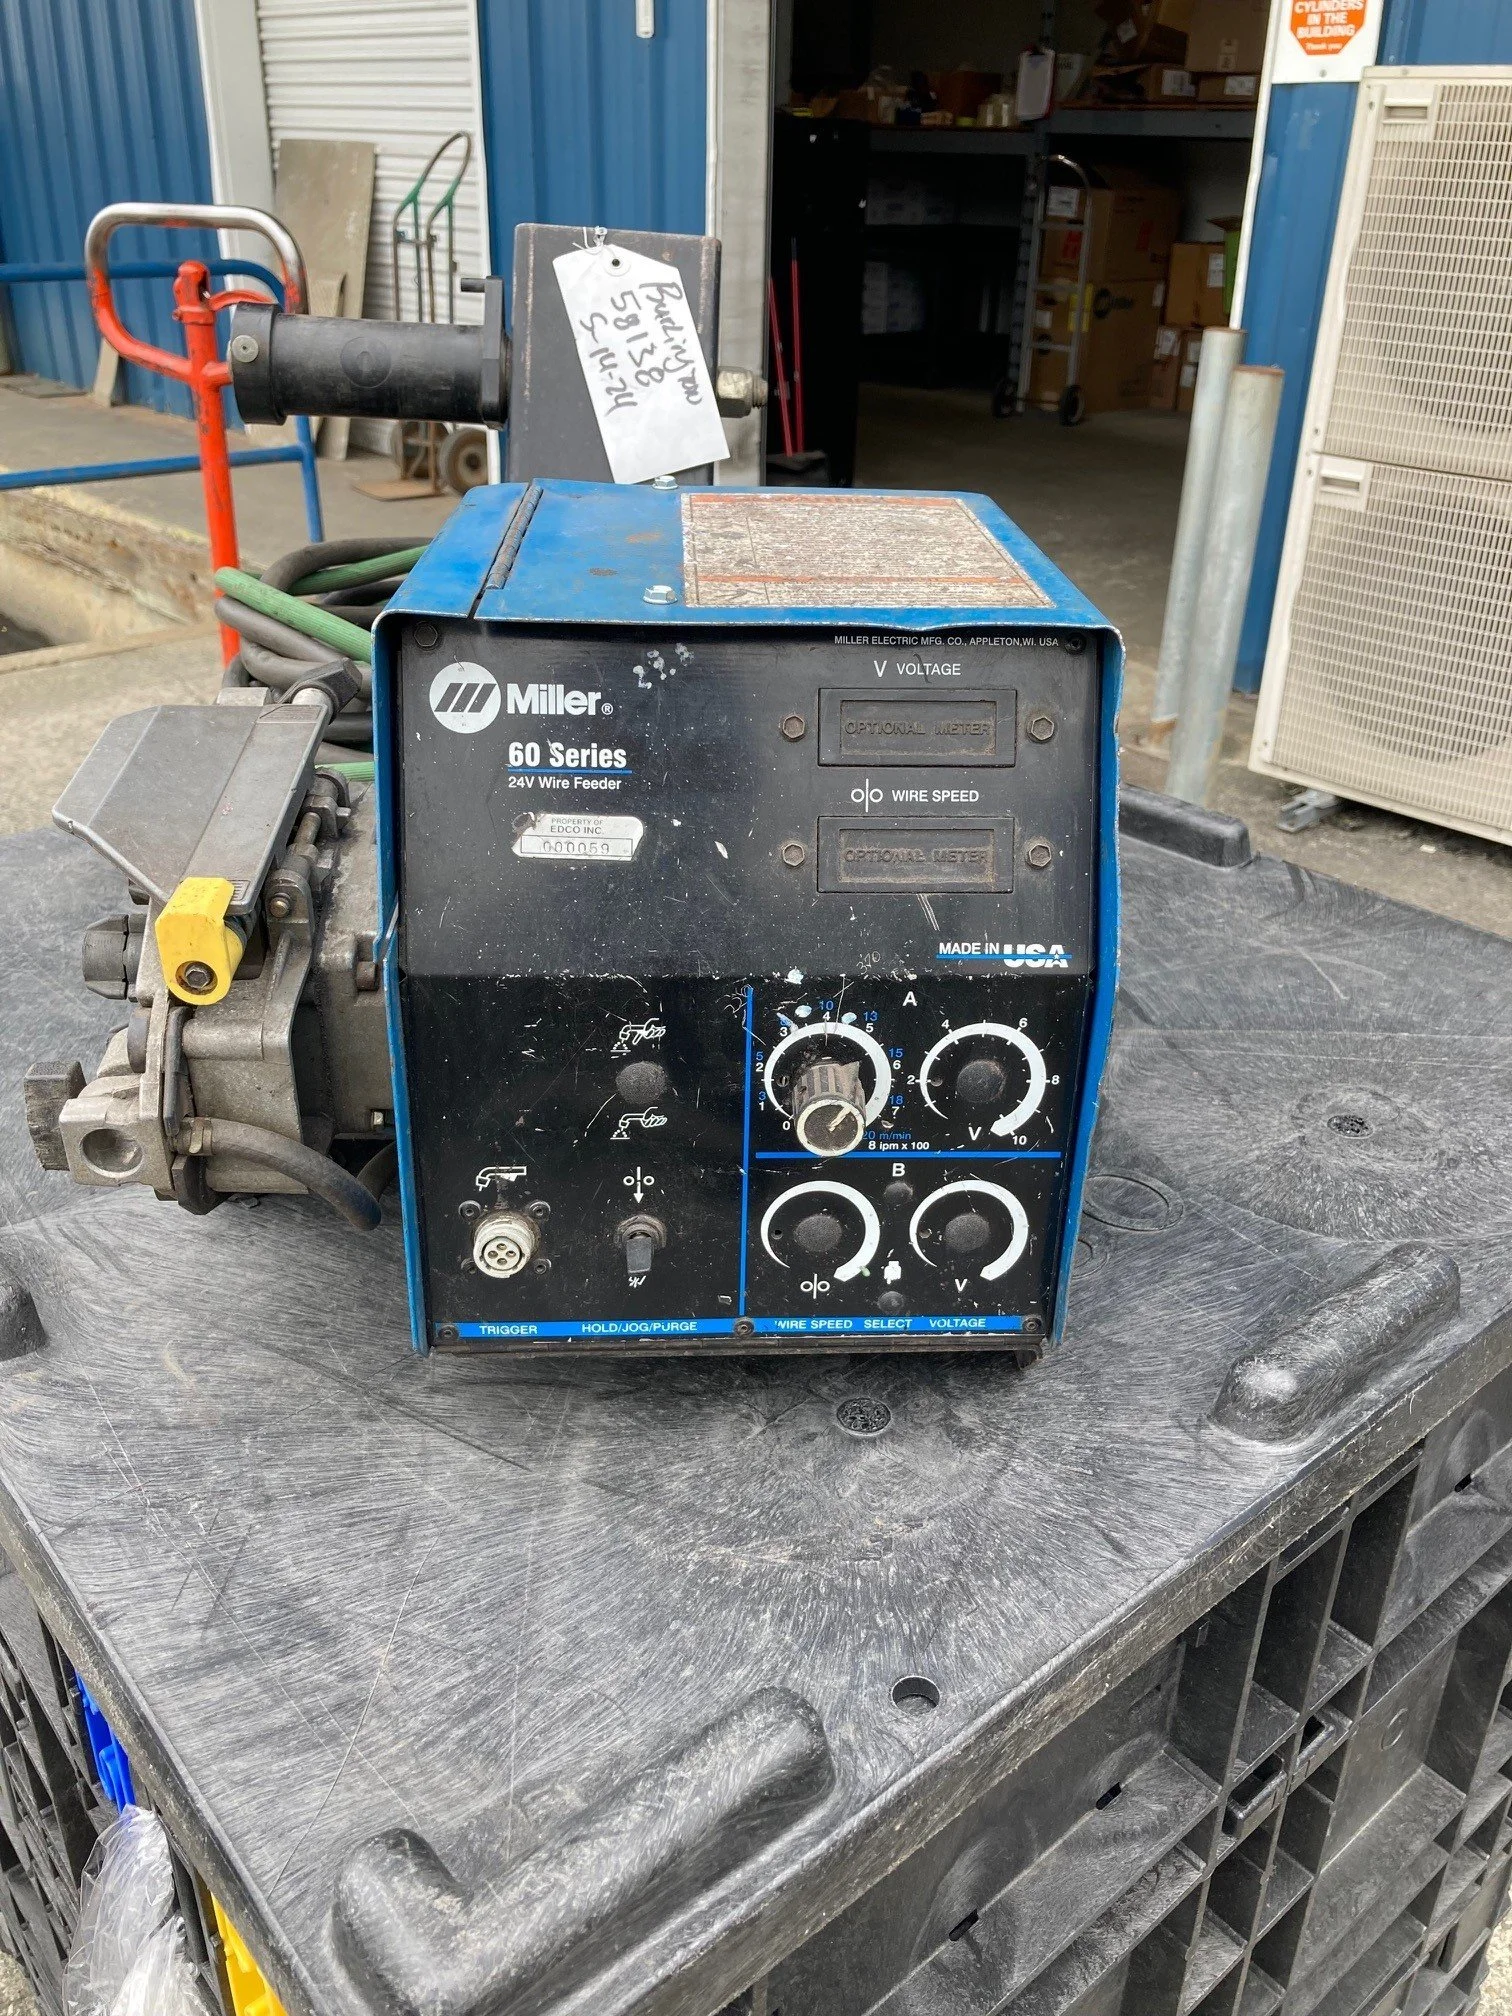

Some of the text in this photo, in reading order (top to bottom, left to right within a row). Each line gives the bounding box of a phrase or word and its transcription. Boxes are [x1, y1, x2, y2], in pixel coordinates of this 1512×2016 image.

[1307, 11, 1348, 25] IN THE
[1296, 24, 1356, 38] BUILDING
[611, 290, 664, 387] 58138
[834, 636, 869, 645] MILLER
[872, 636, 918, 646] ELECTRIC
[920, 636, 945, 646] MFG.
[947, 637, 968, 646] CO.,
[1039, 638, 1059, 647] USA
[896, 662, 961, 676] VOLTAGE
[845, 722, 990, 736] OPTIONAL METER
[508, 742, 627, 768] 60 Series
[508, 776, 622, 790] 24V Wire Feeder
[892, 790, 980, 802] WIRE SPEED
[551, 817, 591, 825] PROPERTY
[550, 826, 580, 834] EDCO
[844, 850, 988, 863] OPTIONAL METER
[939, 942, 1069, 968] MADE IN USA
[903, 992, 917, 1006] A
[818, 1000, 834, 1010] 10
[822, 1012, 832, 1022] 4
[863, 1012, 878, 1022] 13
[866, 1023, 874, 1033] 5
[942, 1020, 950, 1030] 4
[1018, 1018, 1028, 1028] 6
[780, 1026, 788, 1036] 3
[756, 1051, 764, 1061] 5
[888, 1048, 903, 1058] 15
[756, 1062, 764, 1072] 2
[892, 1060, 902, 1069] 6
[906, 1075, 916, 1084] 2
[1051, 1075, 1060, 1086] 8
[759, 1092, 767, 1102] 3
[889, 1094, 904, 1105] 18
[760, 1102, 764, 1111] 1
[892, 1106, 900, 1116] 7
[782, 1120, 790, 1130] 0
[879, 1131, 912, 1140] m/min
[968, 1126, 982, 1141] V
[1012, 1135, 1027, 1146] 10
[868, 1141, 876, 1150] 8
[879, 1142, 899, 1151] ipm
[911, 1142, 930, 1150] 100
[892, 1163, 905, 1176] B
[954, 1278, 968, 1292] V
[582, 1322, 698, 1334] HOLD/JOG/PURGE
[774, 1320, 852, 1329] WIRE SPEED
[864, 1319, 912, 1328] SELECT
[930, 1318, 986, 1328] VOLTAGE
[479, 1325, 538, 1335] TRIGGER
